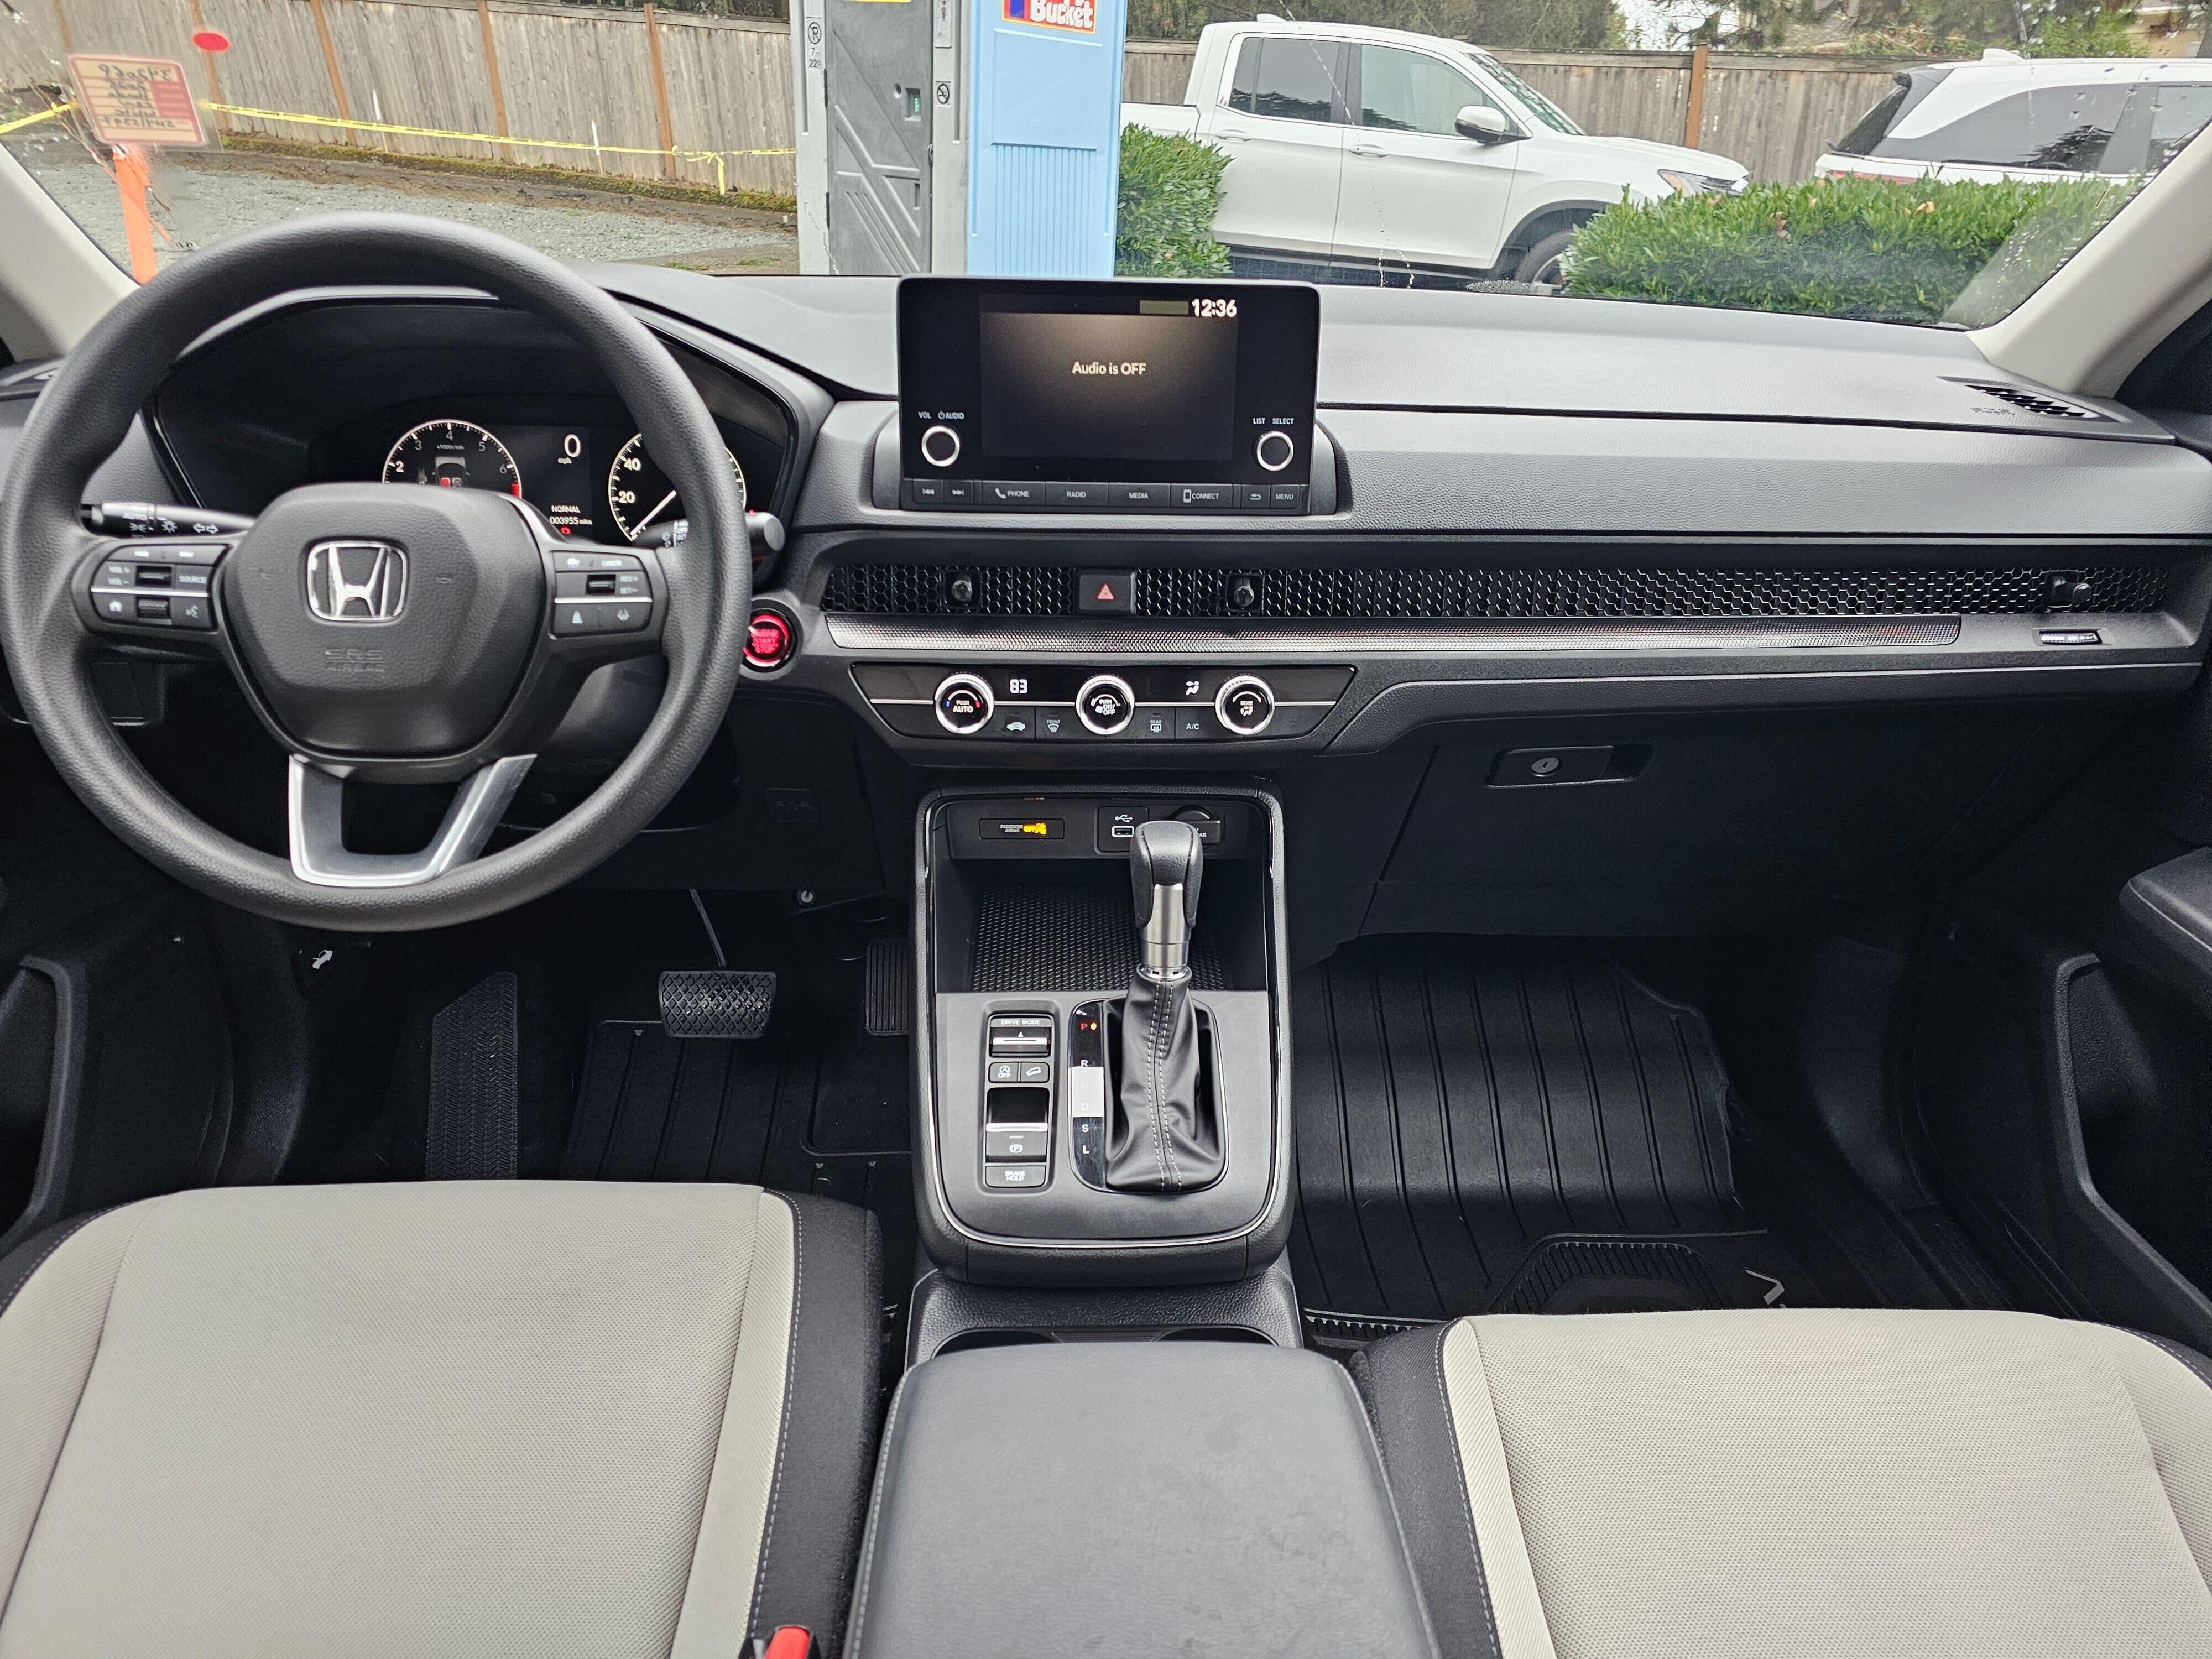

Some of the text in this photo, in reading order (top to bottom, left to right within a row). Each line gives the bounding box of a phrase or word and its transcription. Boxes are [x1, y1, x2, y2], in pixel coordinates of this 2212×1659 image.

[1030, 0, 1094, 28] Bucket
[1192, 298, 1237, 317] 12:36
[1072, 361, 1146, 375] Audio is OFF
[446, 431, 453, 441] 4
[415, 440, 422, 451] 3
[479, 441, 486, 452] 5
[564, 434, 581, 458] 0
[395, 460, 404, 473] 2
[499, 463, 507, 474] 6
[623, 458, 641, 471] 40
[618, 491, 635, 504] 20
[551, 505, 581, 513] NORMAL
[549, 516, 579, 525] 003955
[1010, 679, 1028, 693] 83
[1081, 1124, 1089, 1133] S
[1082, 1145, 1090, 1154] L
